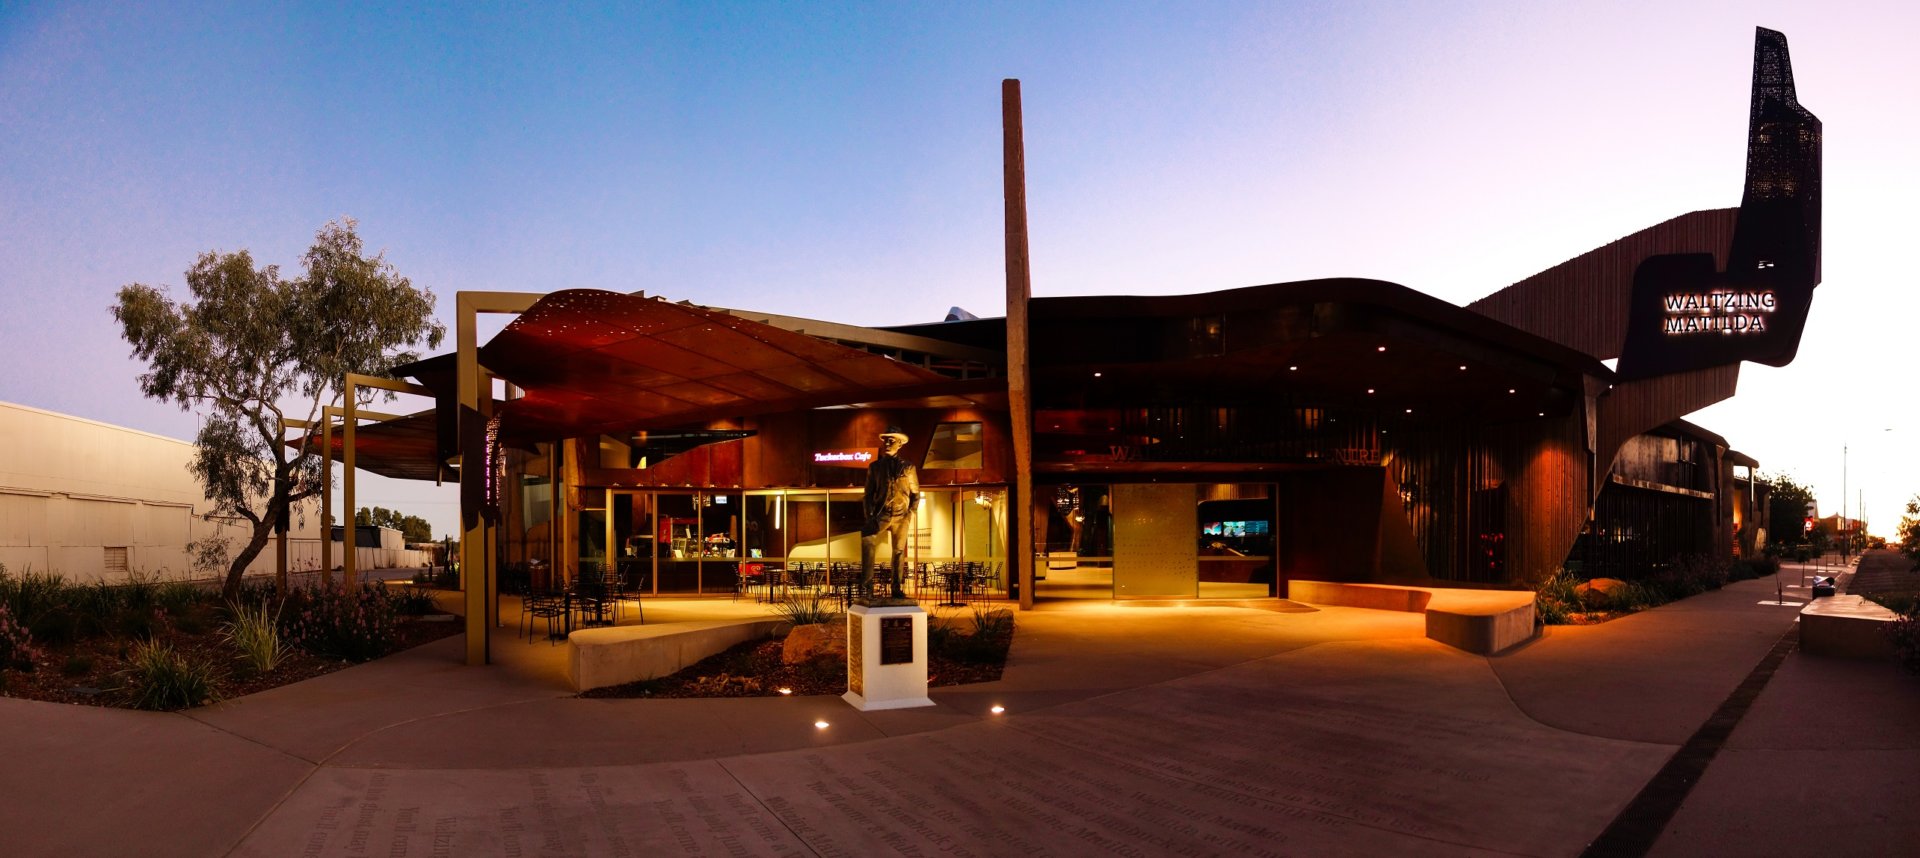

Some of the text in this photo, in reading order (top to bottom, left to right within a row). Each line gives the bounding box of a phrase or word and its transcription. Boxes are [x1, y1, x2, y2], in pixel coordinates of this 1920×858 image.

[1664, 291, 1775, 311] WALTZING
[1664, 313, 1764, 334] MATILDA
[854, 451, 872, 461] Cafe
